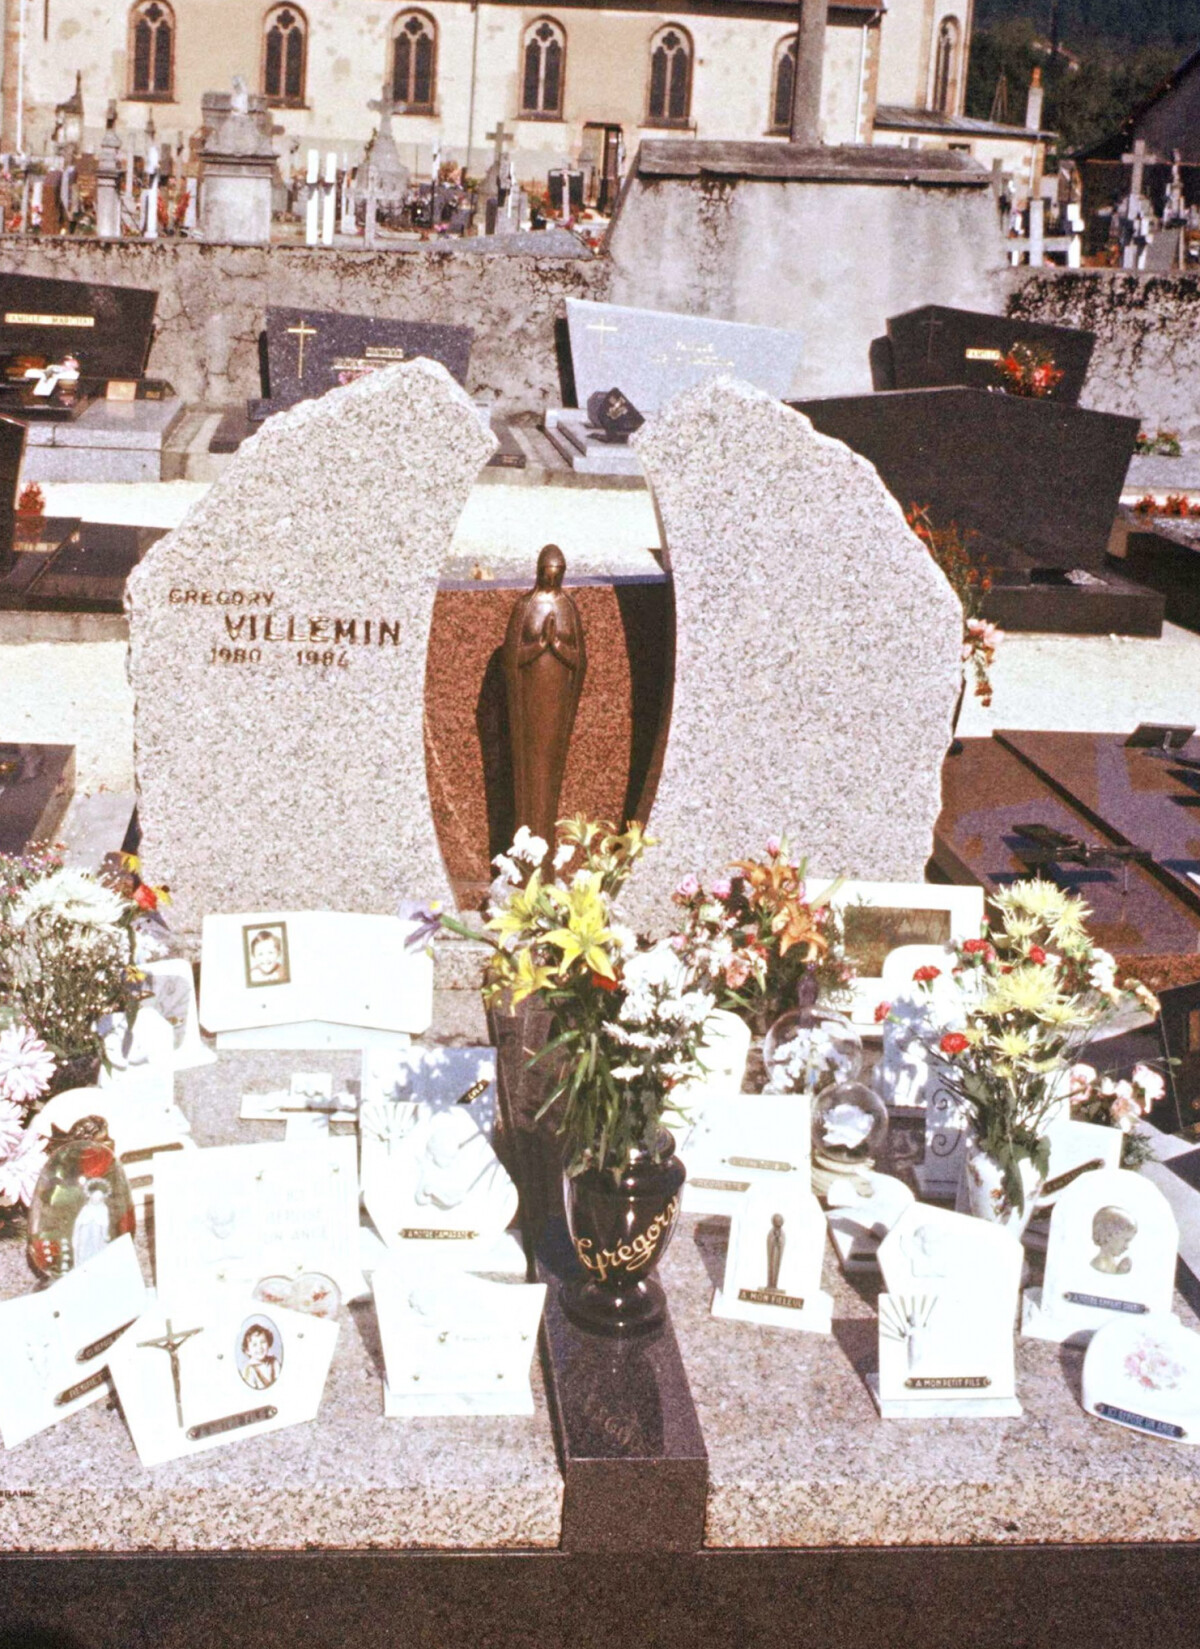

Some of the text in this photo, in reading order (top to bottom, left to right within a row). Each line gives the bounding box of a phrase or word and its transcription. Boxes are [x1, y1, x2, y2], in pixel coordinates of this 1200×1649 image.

[169, 588, 275, 607] GREGORY
[224, 613, 401, 647] VILLEMIN
[211, 648, 350, 668] 1980 1984
[923, 1379, 942, 1389] MON
[965, 1378, 981, 1388] FILS
